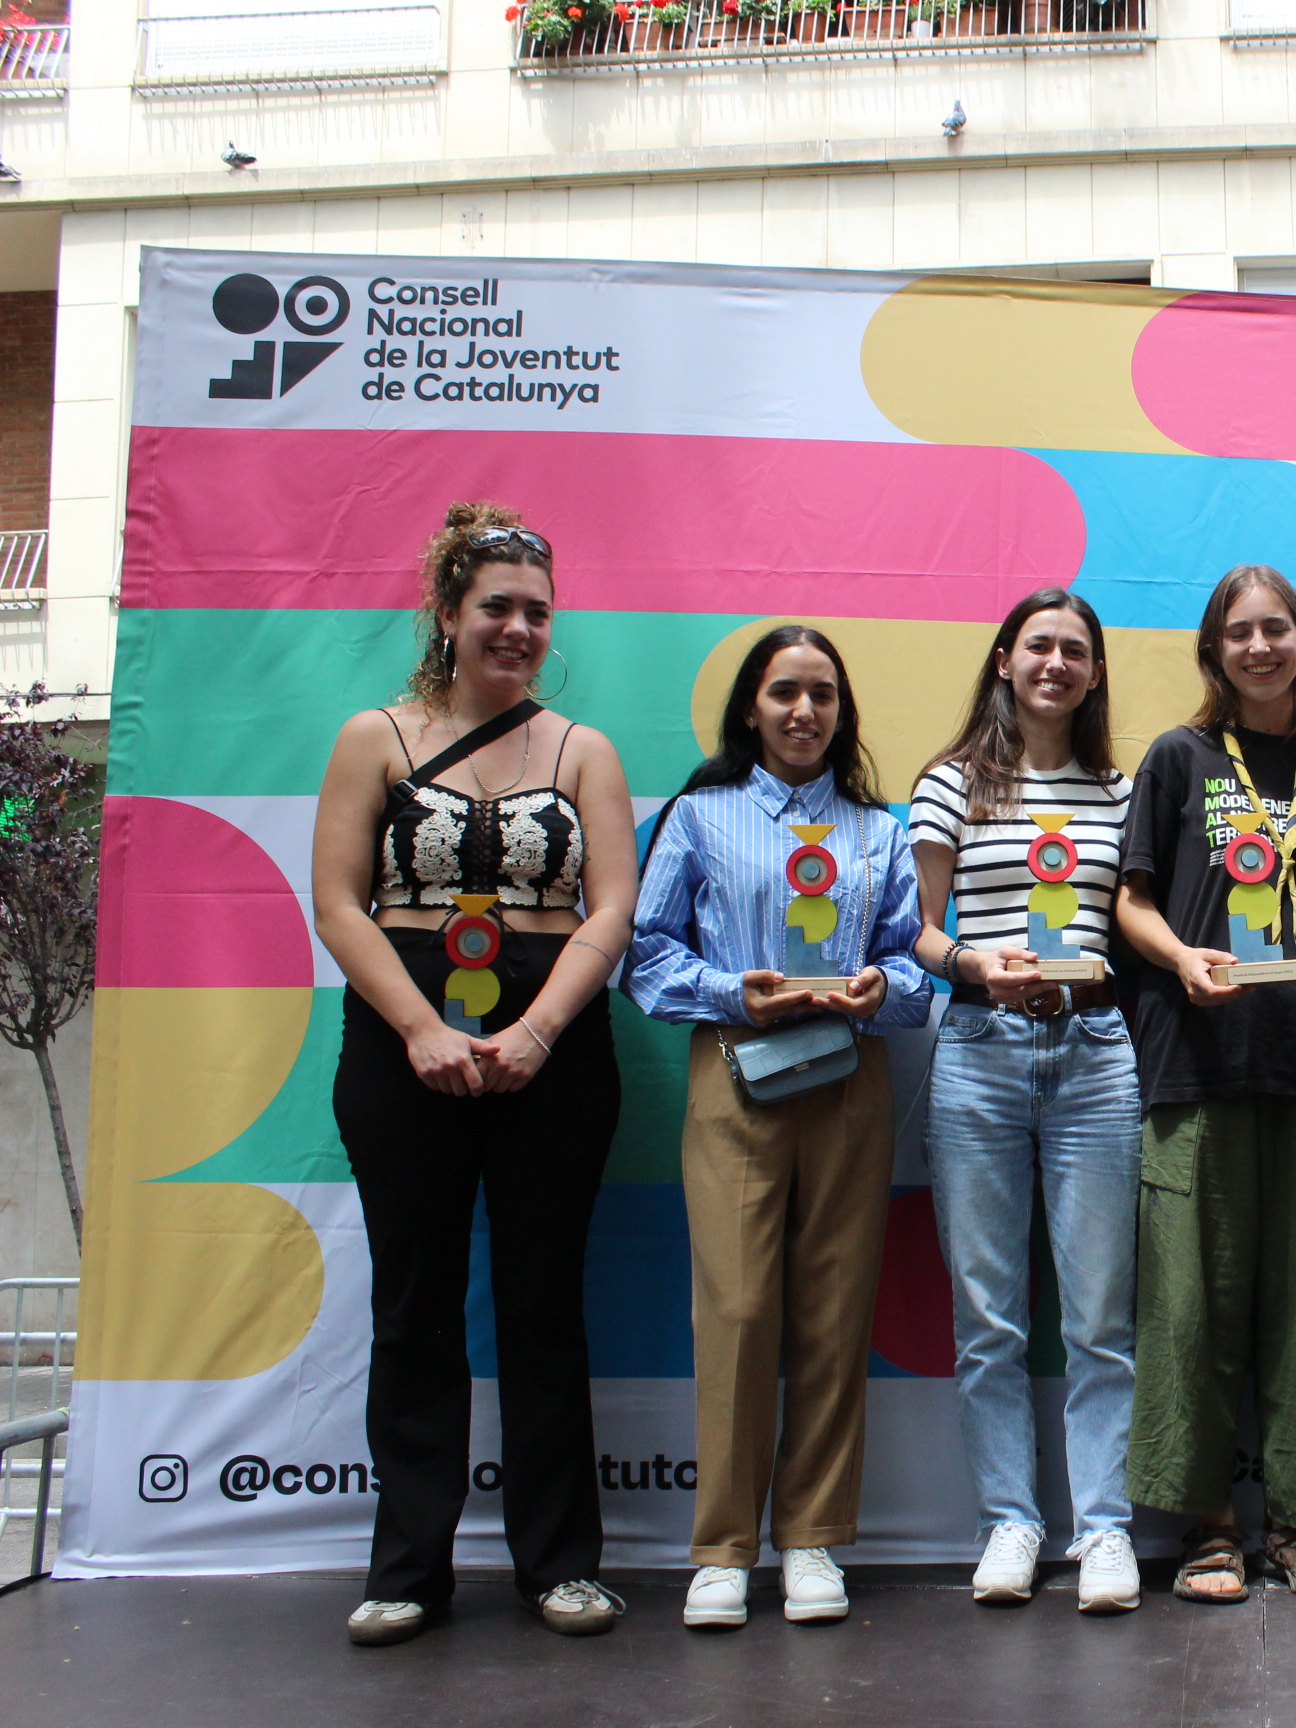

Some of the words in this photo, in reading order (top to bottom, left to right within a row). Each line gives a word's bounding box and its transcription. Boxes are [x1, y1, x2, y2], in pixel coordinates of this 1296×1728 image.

[367, 277, 499, 306] Consell
[367, 308, 523, 337] Nacional
[364, 340, 408, 368] de
[417, 340, 448, 368] la
[455, 342, 620, 371] Joventut
[361, 372, 405, 401] de
[414, 373, 600, 410] Catalunya
[1204, 778, 1236, 794] NOU
[1206, 812, 1228, 829] AL
